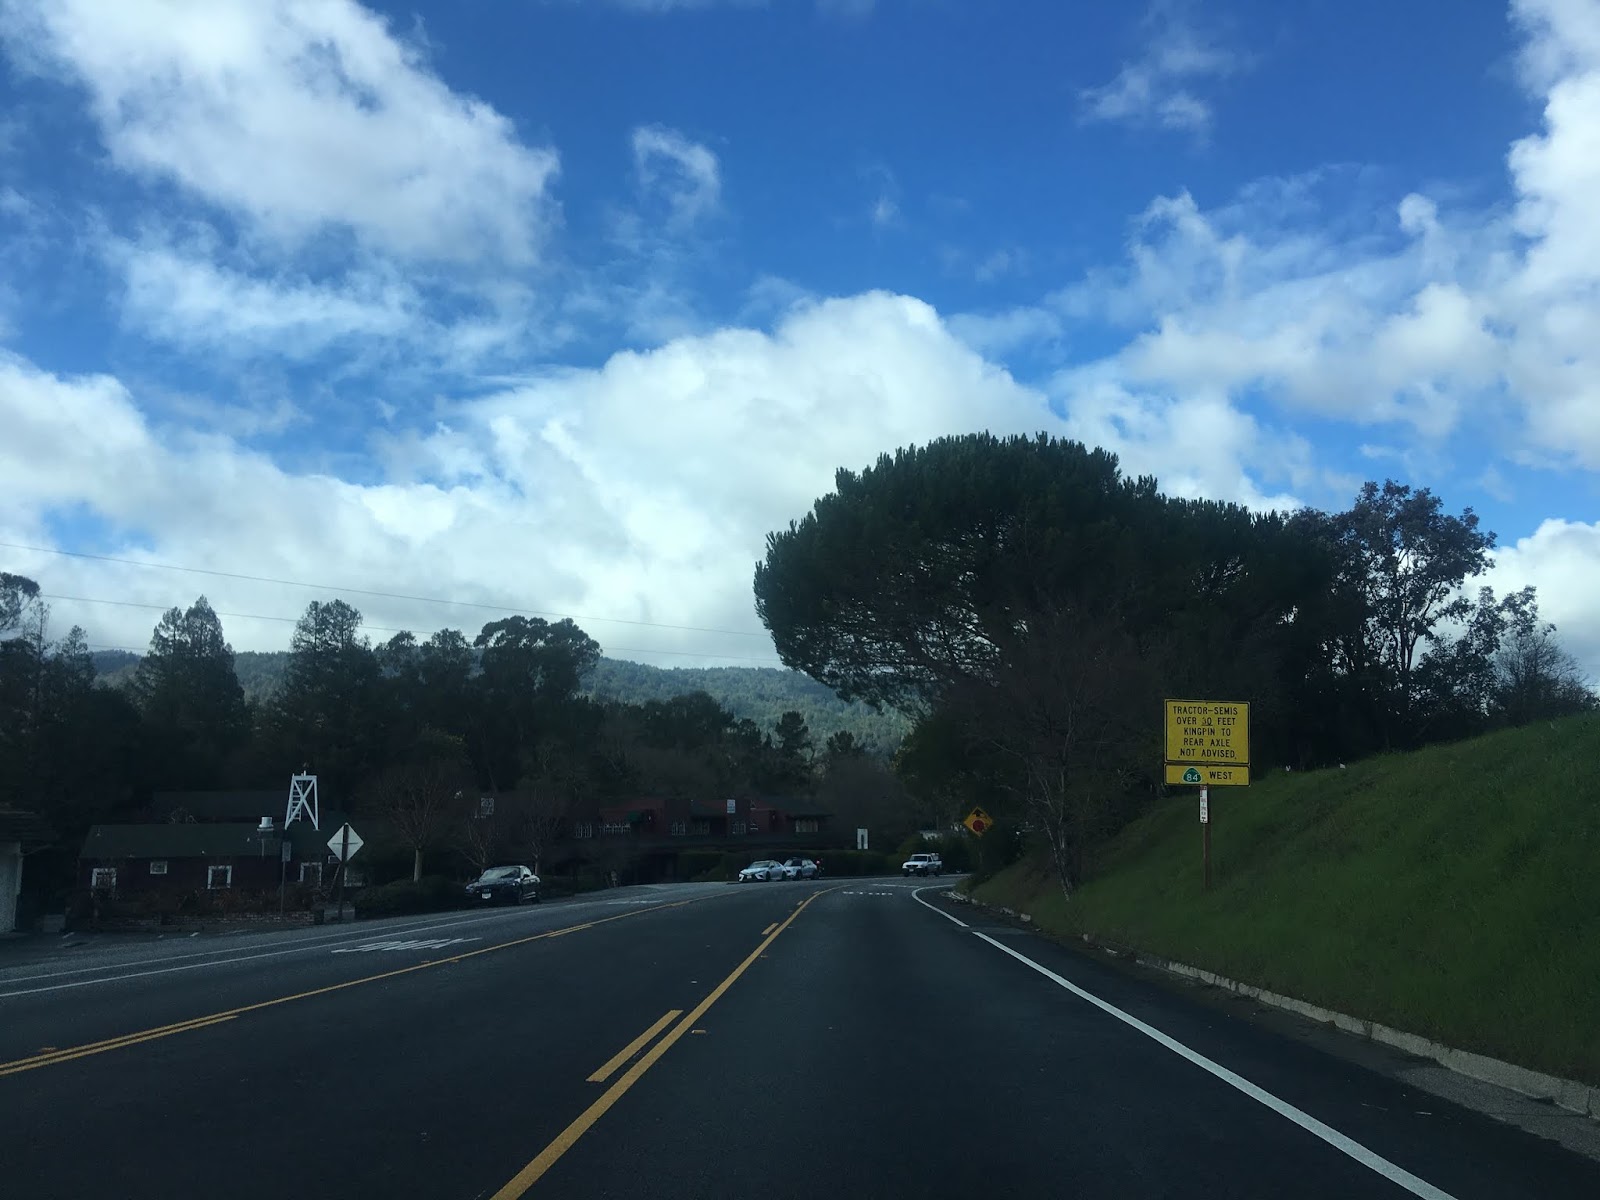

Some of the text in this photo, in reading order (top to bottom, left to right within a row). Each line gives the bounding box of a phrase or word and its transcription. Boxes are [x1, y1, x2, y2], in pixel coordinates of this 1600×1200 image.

[1173, 706, 1238, 715] TRACTOR-SEMIS
[1176, 717, 1197, 725] OVER
[1217, 717, 1236, 726] FEET
[1184, 728, 1231, 736] KINGPIN TO
[1183, 738, 1230, 747] REAR AXLE
[1180, 749, 1235, 758] NOT ADVISED
[1186, 771, 1233, 781] 84 WEST
